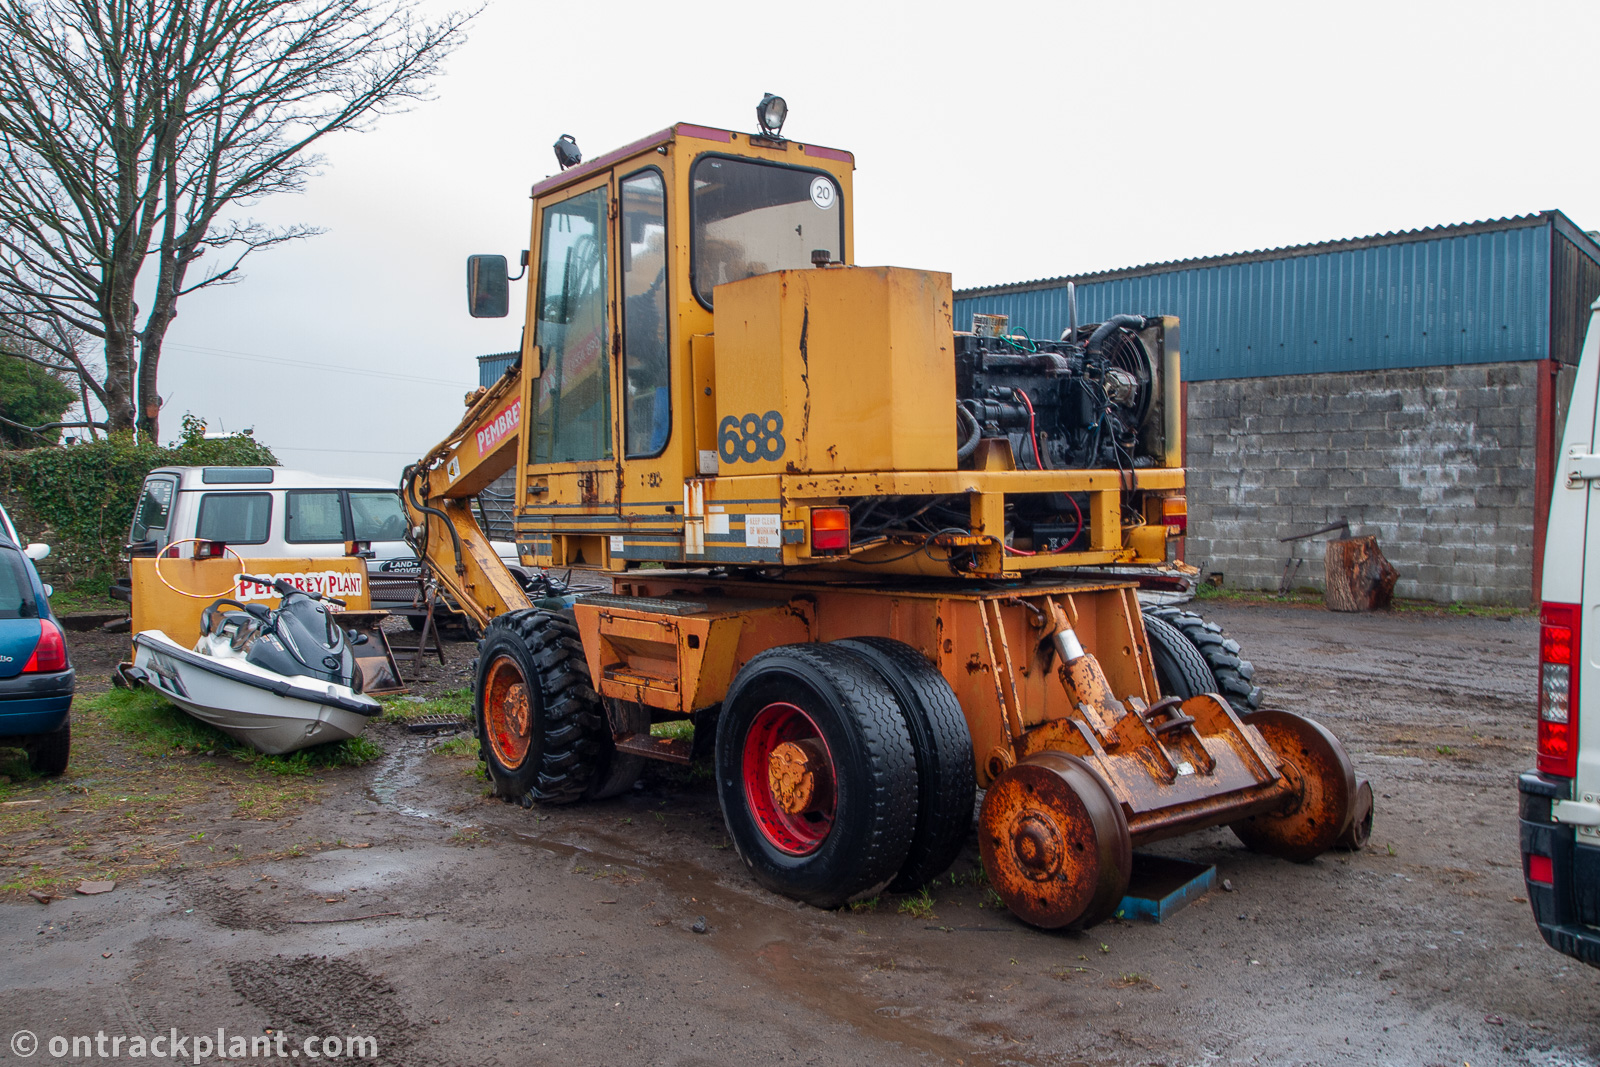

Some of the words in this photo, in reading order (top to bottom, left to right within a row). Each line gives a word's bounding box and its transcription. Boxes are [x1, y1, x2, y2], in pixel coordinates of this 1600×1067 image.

[816, 186, 829, 199] 20
[717, 410, 786, 464] 688
[749, 526, 755, 535] OF
[756, 526, 777, 535] WORKING
[757, 536, 769, 544] AREA
[390, 560, 413, 569] LAND
[328, 575, 361, 593] PLANT
